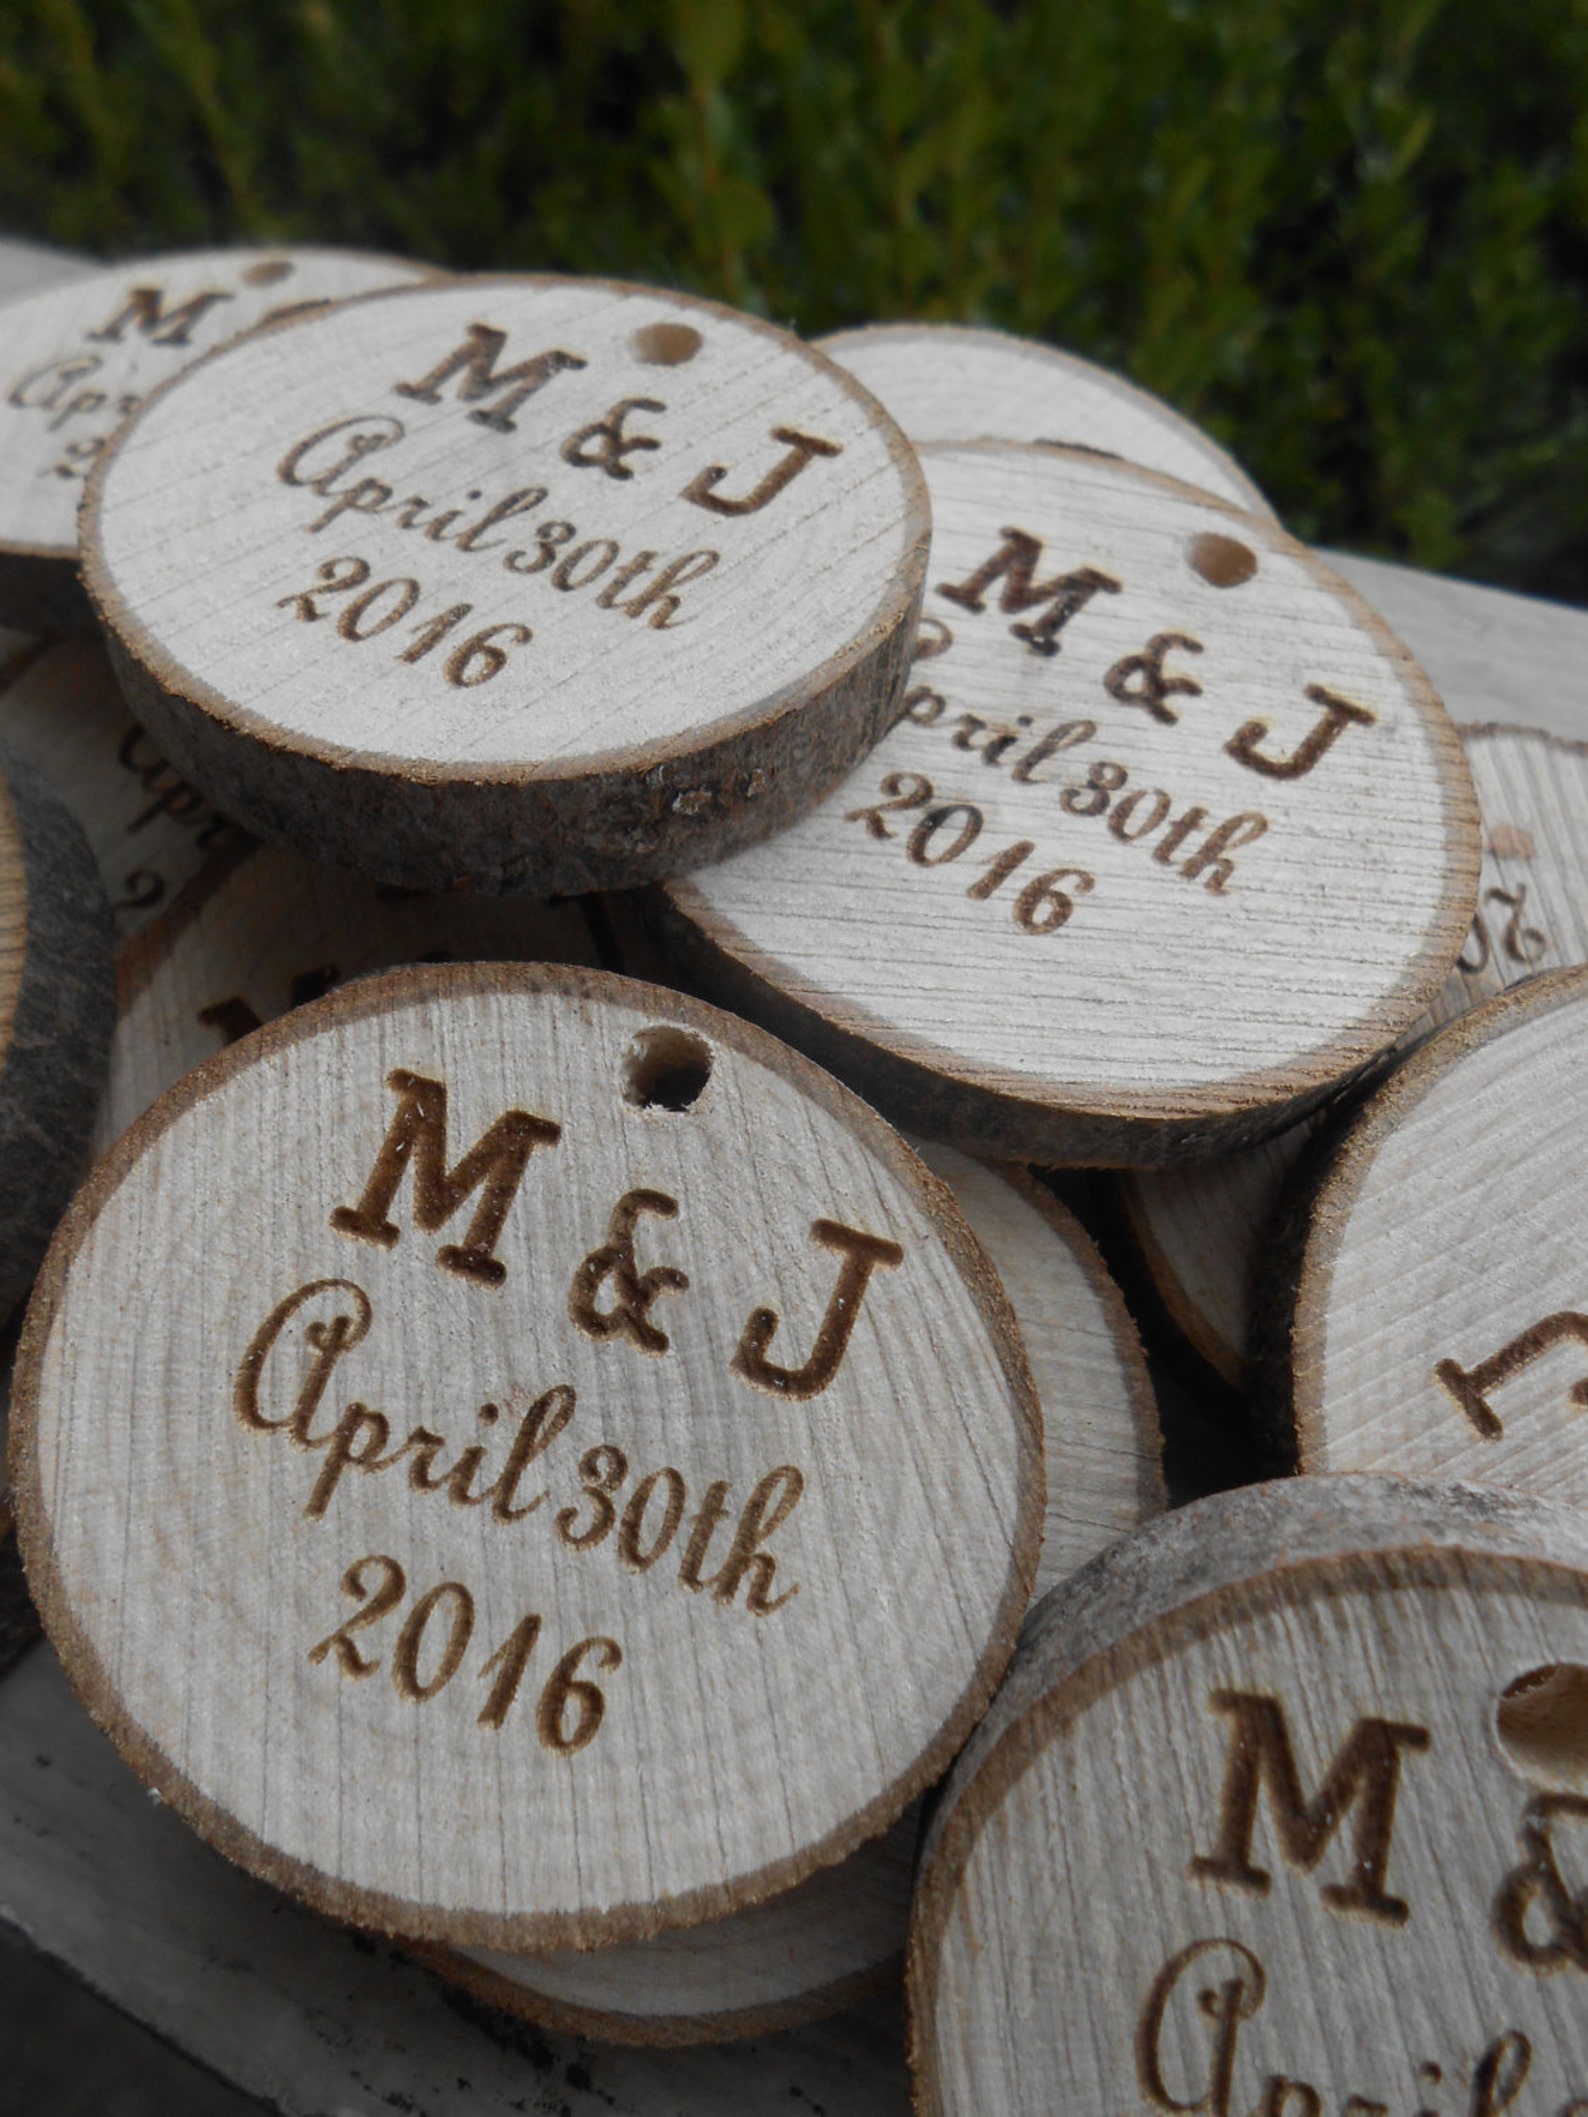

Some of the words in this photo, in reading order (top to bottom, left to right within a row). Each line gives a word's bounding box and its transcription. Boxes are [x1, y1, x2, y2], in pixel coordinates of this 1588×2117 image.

[86, 286, 235, 348] M
[395, 322, 588, 434] M
[559, 397, 667, 480] &
[679, 425, 844, 517] J
[276, 414, 550, 552] April
[503, 520, 721, 630] 30th
[276, 556, 533, 688] 2016
[903, 617, 1097, 785] pril
[936, 526, 1123, 657] M
[1104, 632, 1204, 726] &
[1224, 683, 1376, 780] J
[845, 772, 1095, 936] 2016
[330, 1068, 561, 1289] M
[567, 1189, 689, 1357] &
[730, 1217, 903, 1401] J
[233, 1278, 577, 1524] April
[555, 1445, 804, 1617] 30th
[309, 1555, 622, 1757] 2016
[1187, 1687, 1431, 1929] M
